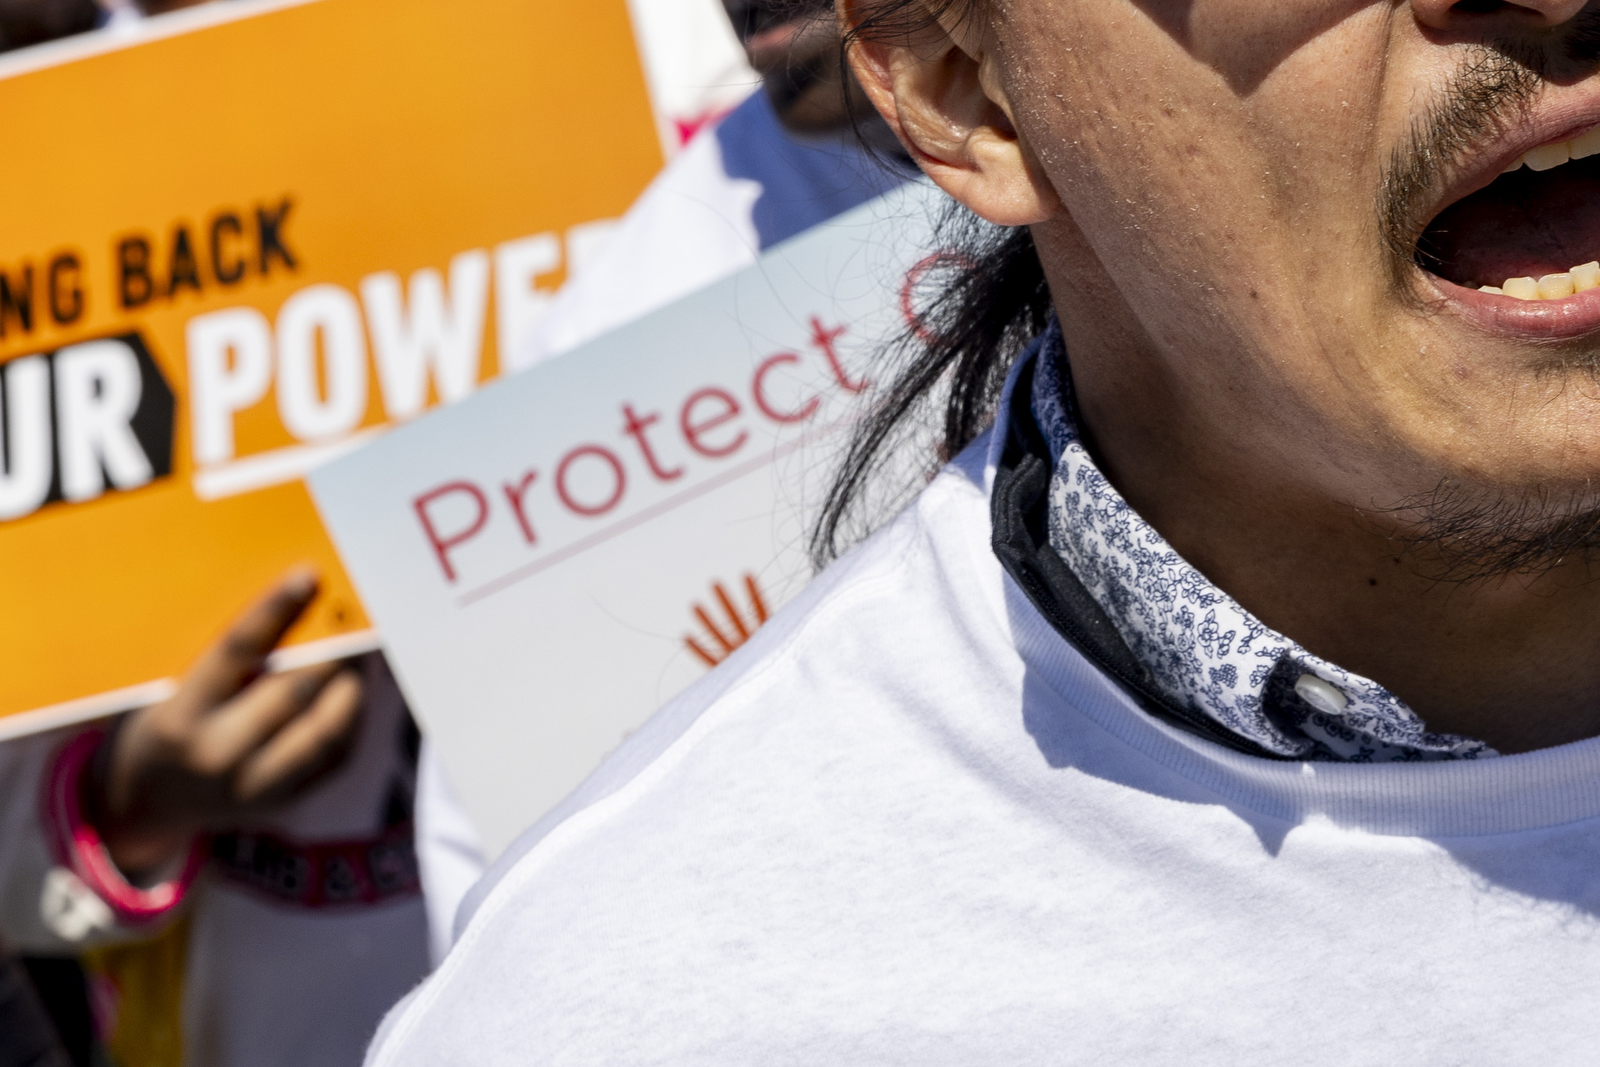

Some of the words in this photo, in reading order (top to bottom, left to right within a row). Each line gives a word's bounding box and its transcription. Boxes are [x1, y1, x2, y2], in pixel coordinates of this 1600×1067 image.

[115, 193, 299, 311] BACK
[185, 215, 618, 465] POWE
[411, 315, 870, 584] Protect
